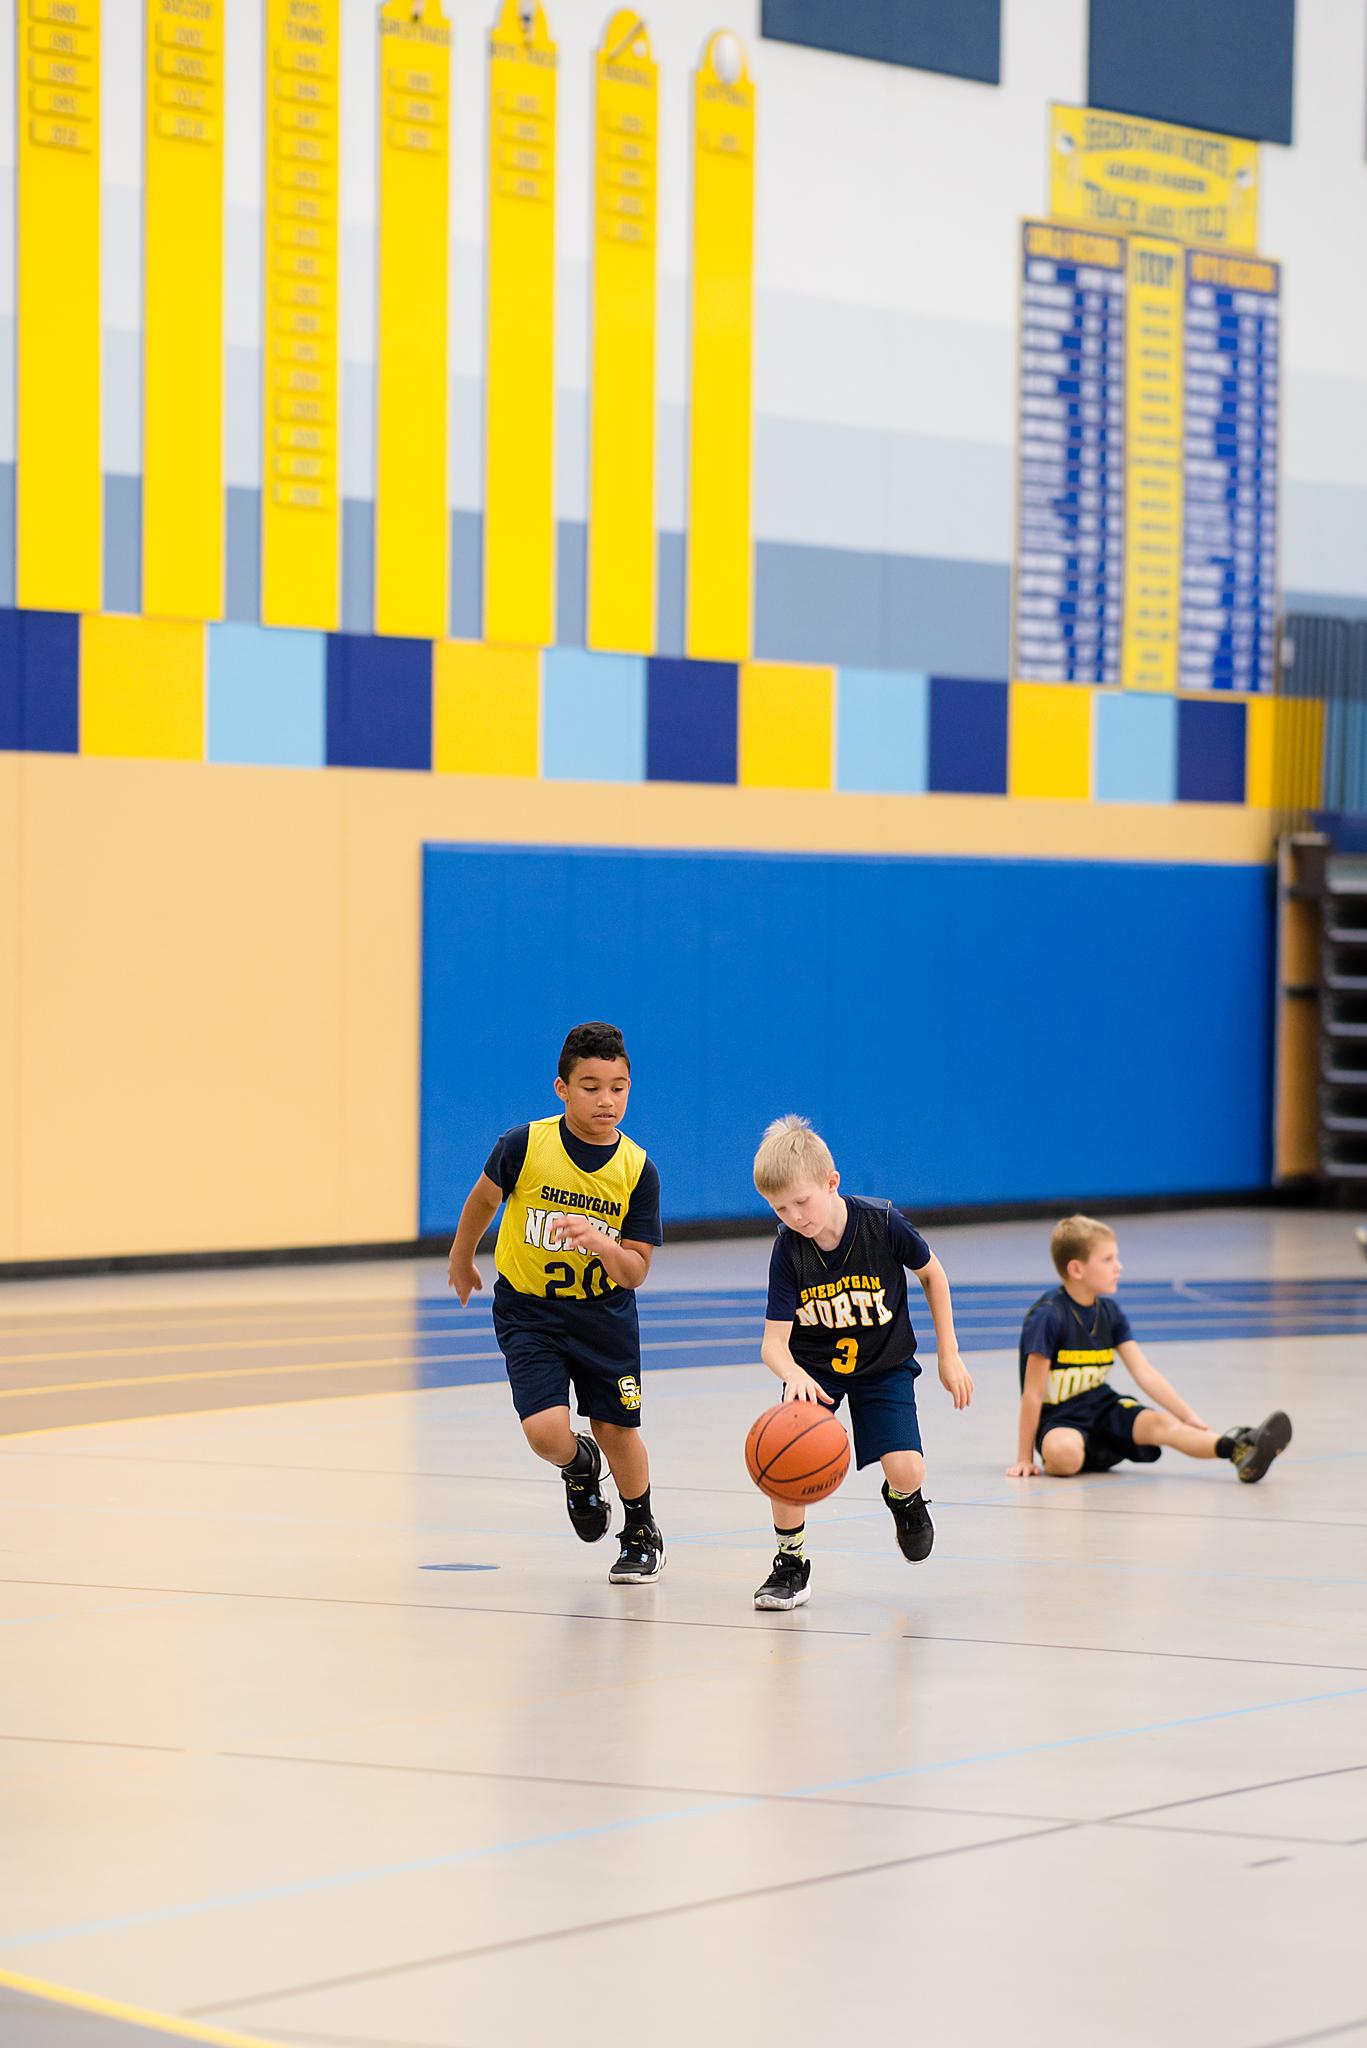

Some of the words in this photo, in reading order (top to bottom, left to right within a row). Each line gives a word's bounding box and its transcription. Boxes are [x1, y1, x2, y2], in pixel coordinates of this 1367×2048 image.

[541, 1185, 621, 1217] SHEBOYGAN
[544, 1258, 612, 1300] 20
[800, 1275, 881, 1303] SHEBOYGAN
[831, 1337, 859, 1375] 3
